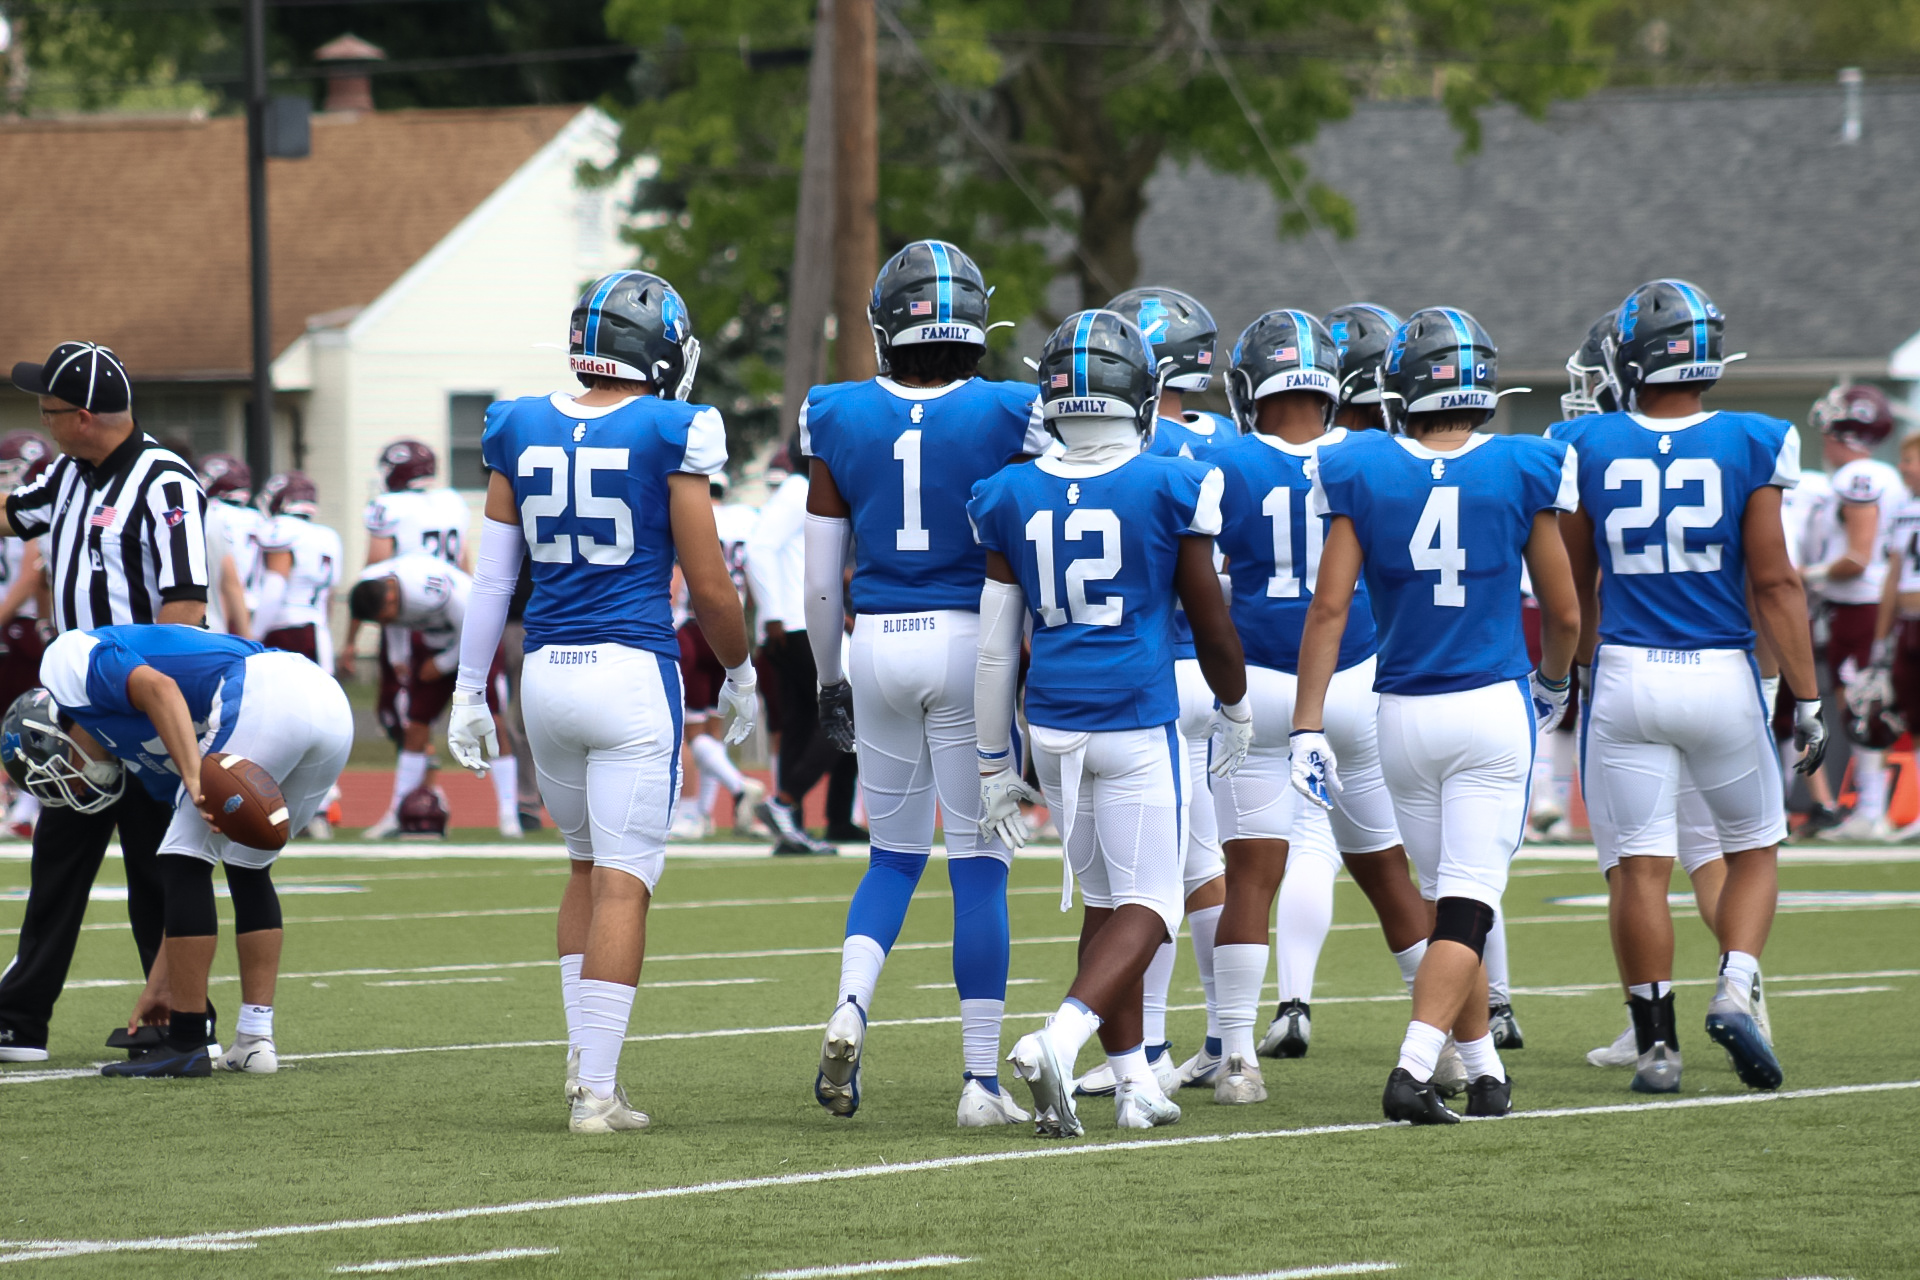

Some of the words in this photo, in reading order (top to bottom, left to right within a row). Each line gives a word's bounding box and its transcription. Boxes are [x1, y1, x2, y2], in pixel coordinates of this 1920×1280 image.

[921, 326, 970, 340] FAMILY
[570, 357, 616, 375] Riddell
[1475, 363, 1487, 380] C
[1677, 366, 1720, 380] FAMILY
[1285, 372, 1330, 388] FAMILY
[1058, 400, 1107, 414] FAMILY
[1440, 394, 1488, 408] FAMILY
[893, 429, 930, 551] 1
[517, 446, 634, 566] 25
[1604, 458, 1723, 575] 22
[1408, 486, 1467, 608] 4
[1025, 508, 1124, 628] 12
[883, 617, 936, 633] BLUEBOYS
[549, 651, 598, 664] BLUEBOYS
[1646, 650, 1701, 665] BLUEBOYS
